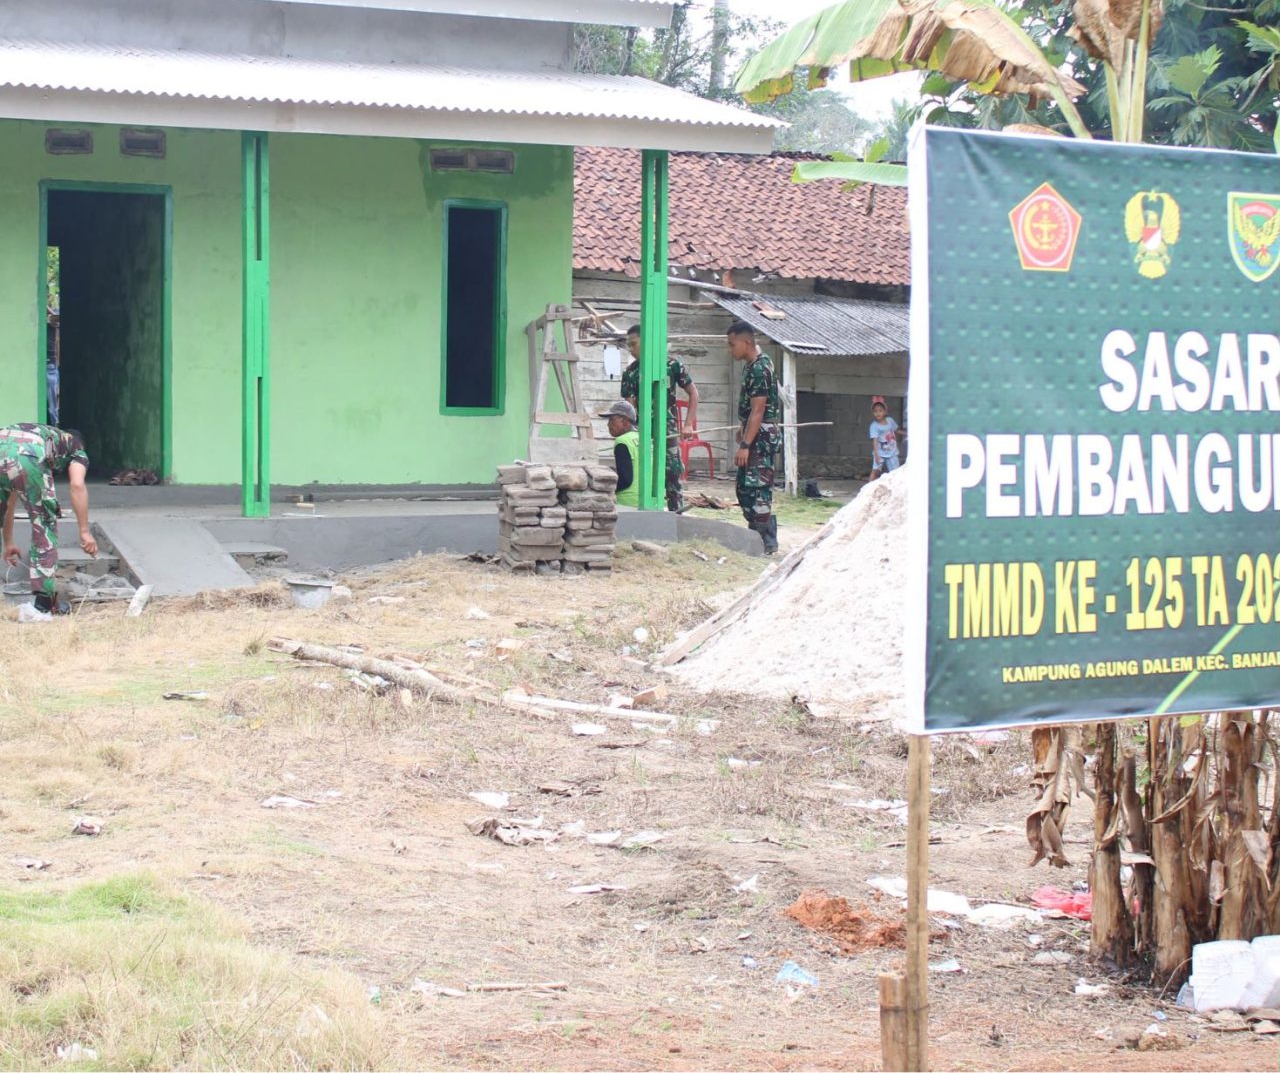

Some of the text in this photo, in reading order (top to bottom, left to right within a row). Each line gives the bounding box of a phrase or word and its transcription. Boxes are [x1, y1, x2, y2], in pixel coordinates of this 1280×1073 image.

[1099, 329, 1280, 412] SASAR
[946, 432, 1280, 518] PEMBANGU
[944, 562, 1045, 639] TMMD
[1055, 560, 1097, 634] KE
[1105, 595, 1117, 613] -
[1126, 556, 1184, 631] 125
[1192, 555, 1230, 626] TA
[1002, 664, 1081, 683] KAMPUNG
[1085, 659, 1138, 678] AGUNG
[1142, 656, 1193, 675] DALEM
[1196, 654, 1229, 671] KEC.
